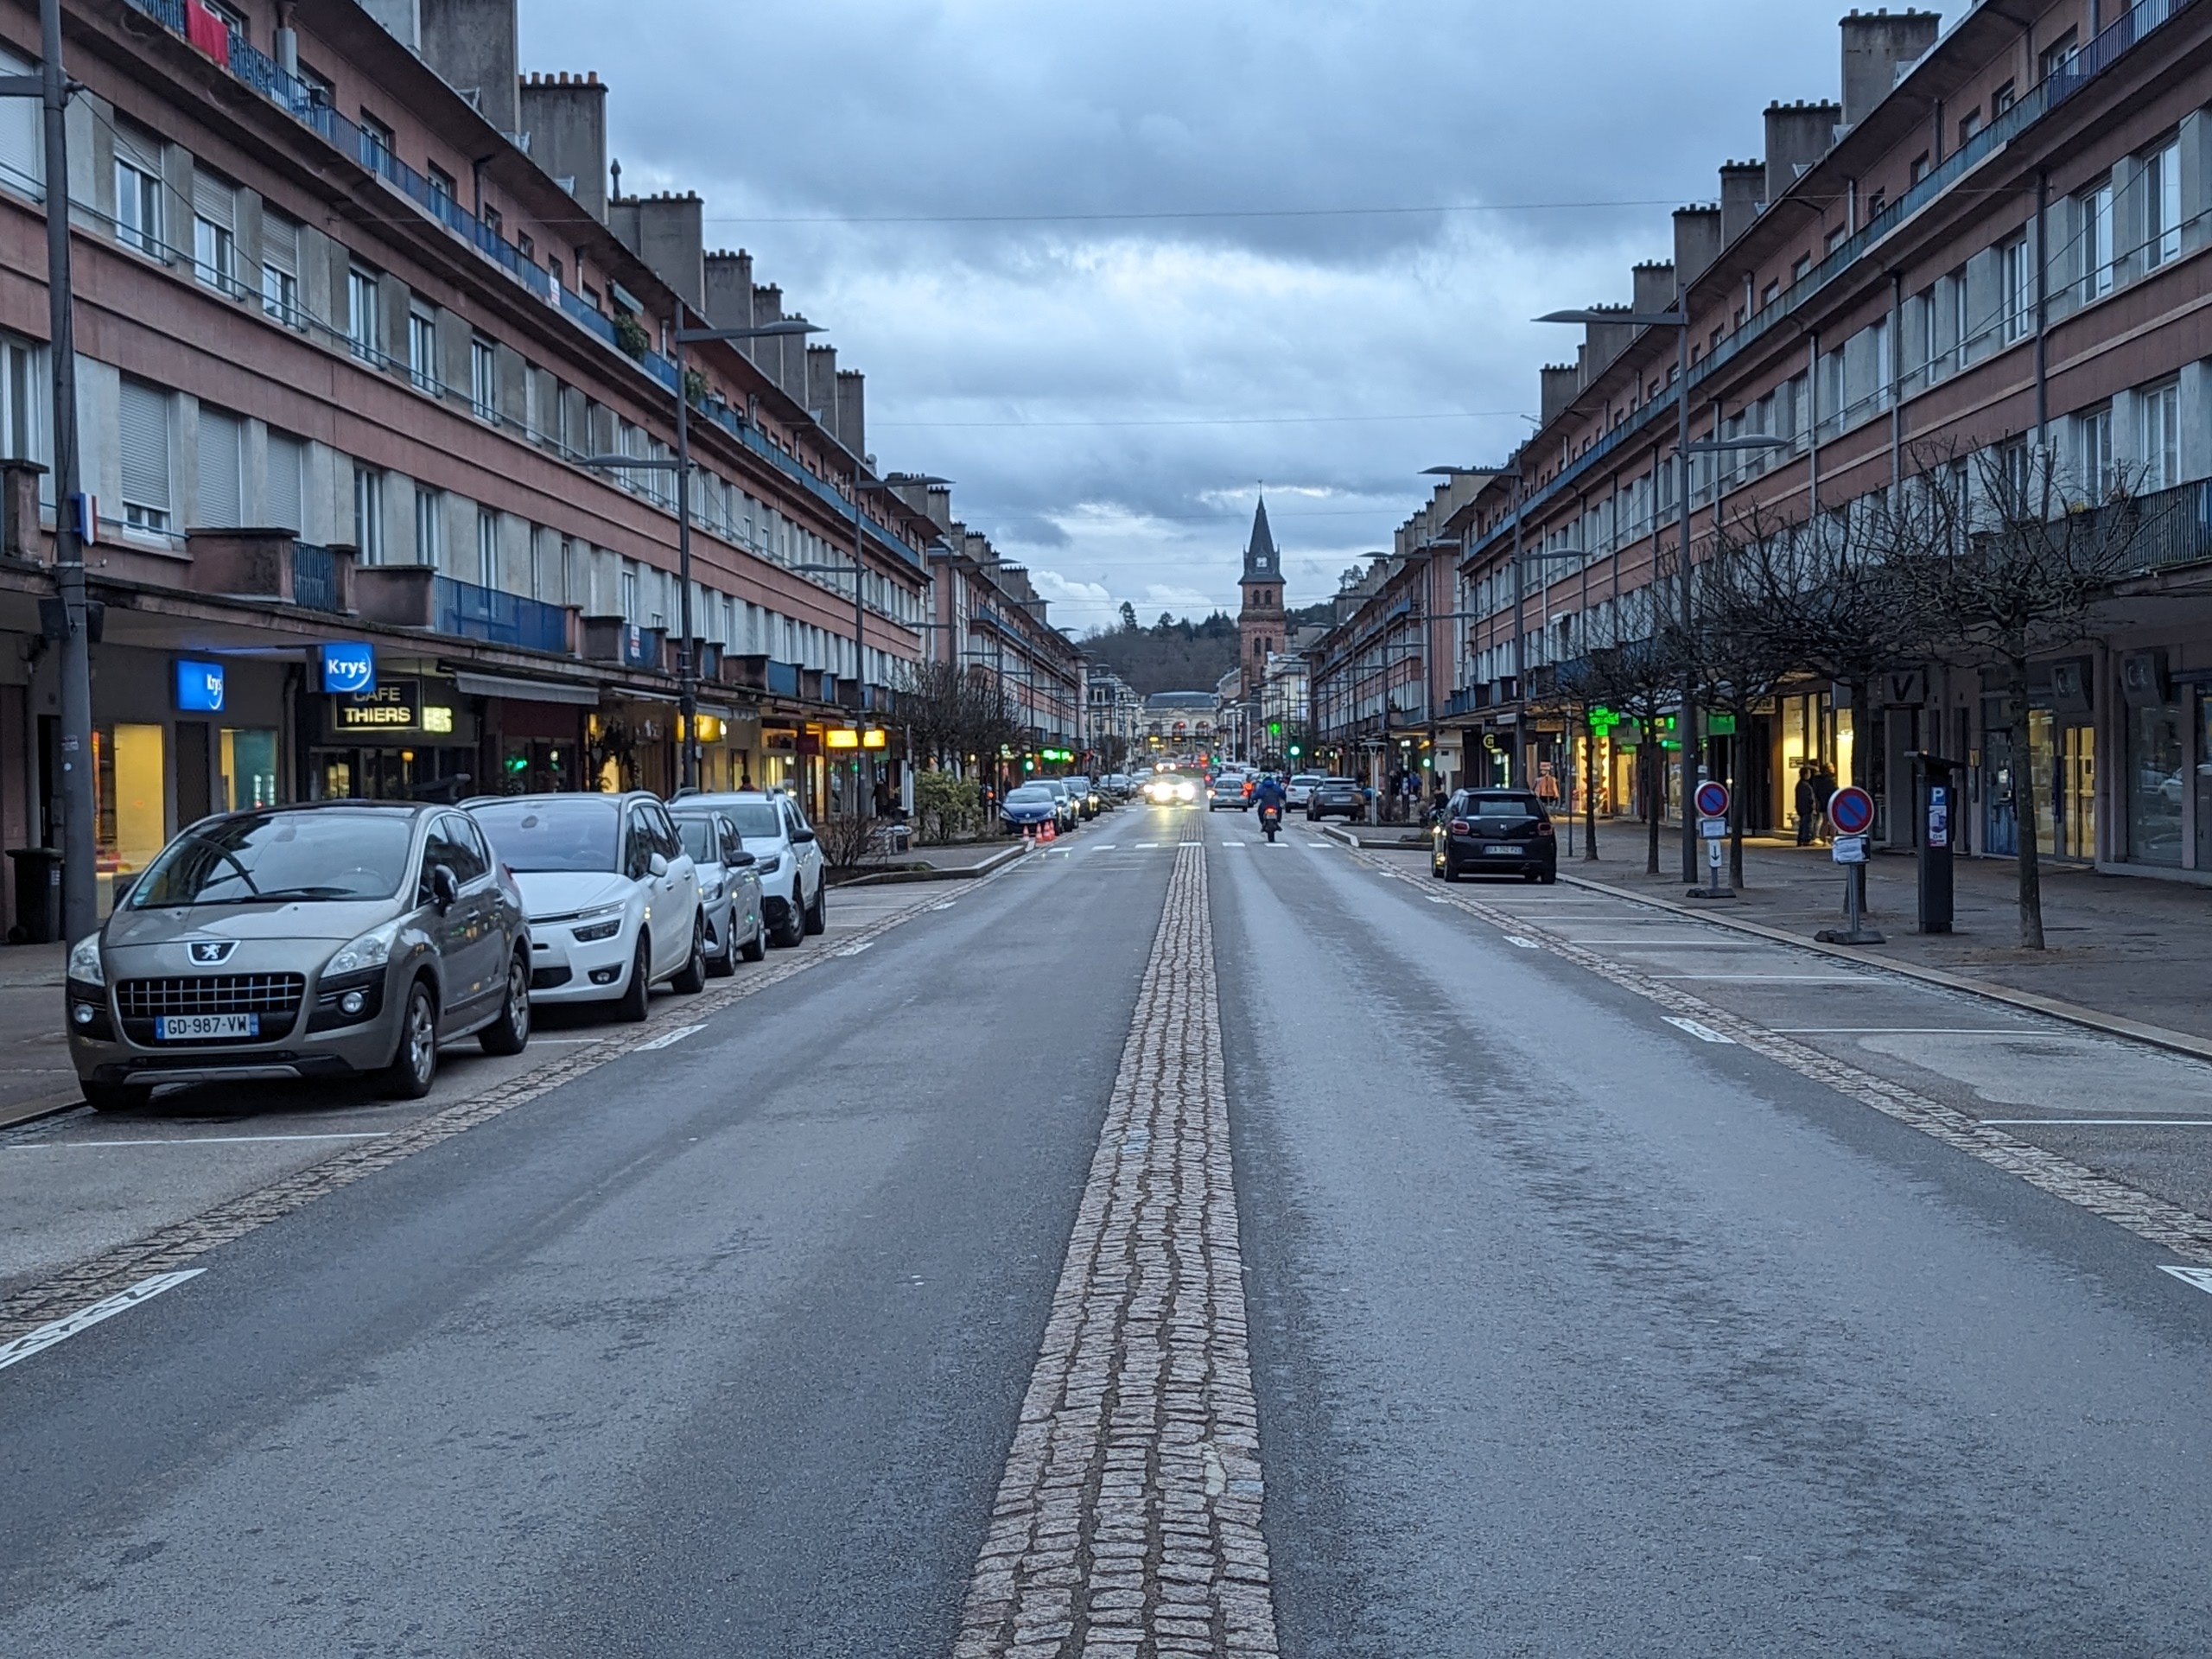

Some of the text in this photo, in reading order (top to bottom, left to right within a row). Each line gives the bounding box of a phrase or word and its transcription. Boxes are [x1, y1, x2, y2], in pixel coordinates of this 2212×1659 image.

[327, 658, 367, 679] Krys
[343, 707, 411, 723] THIERS
[1932, 786, 1945, 803] P
[167, 1015, 247, 1035] GD-987-VW
